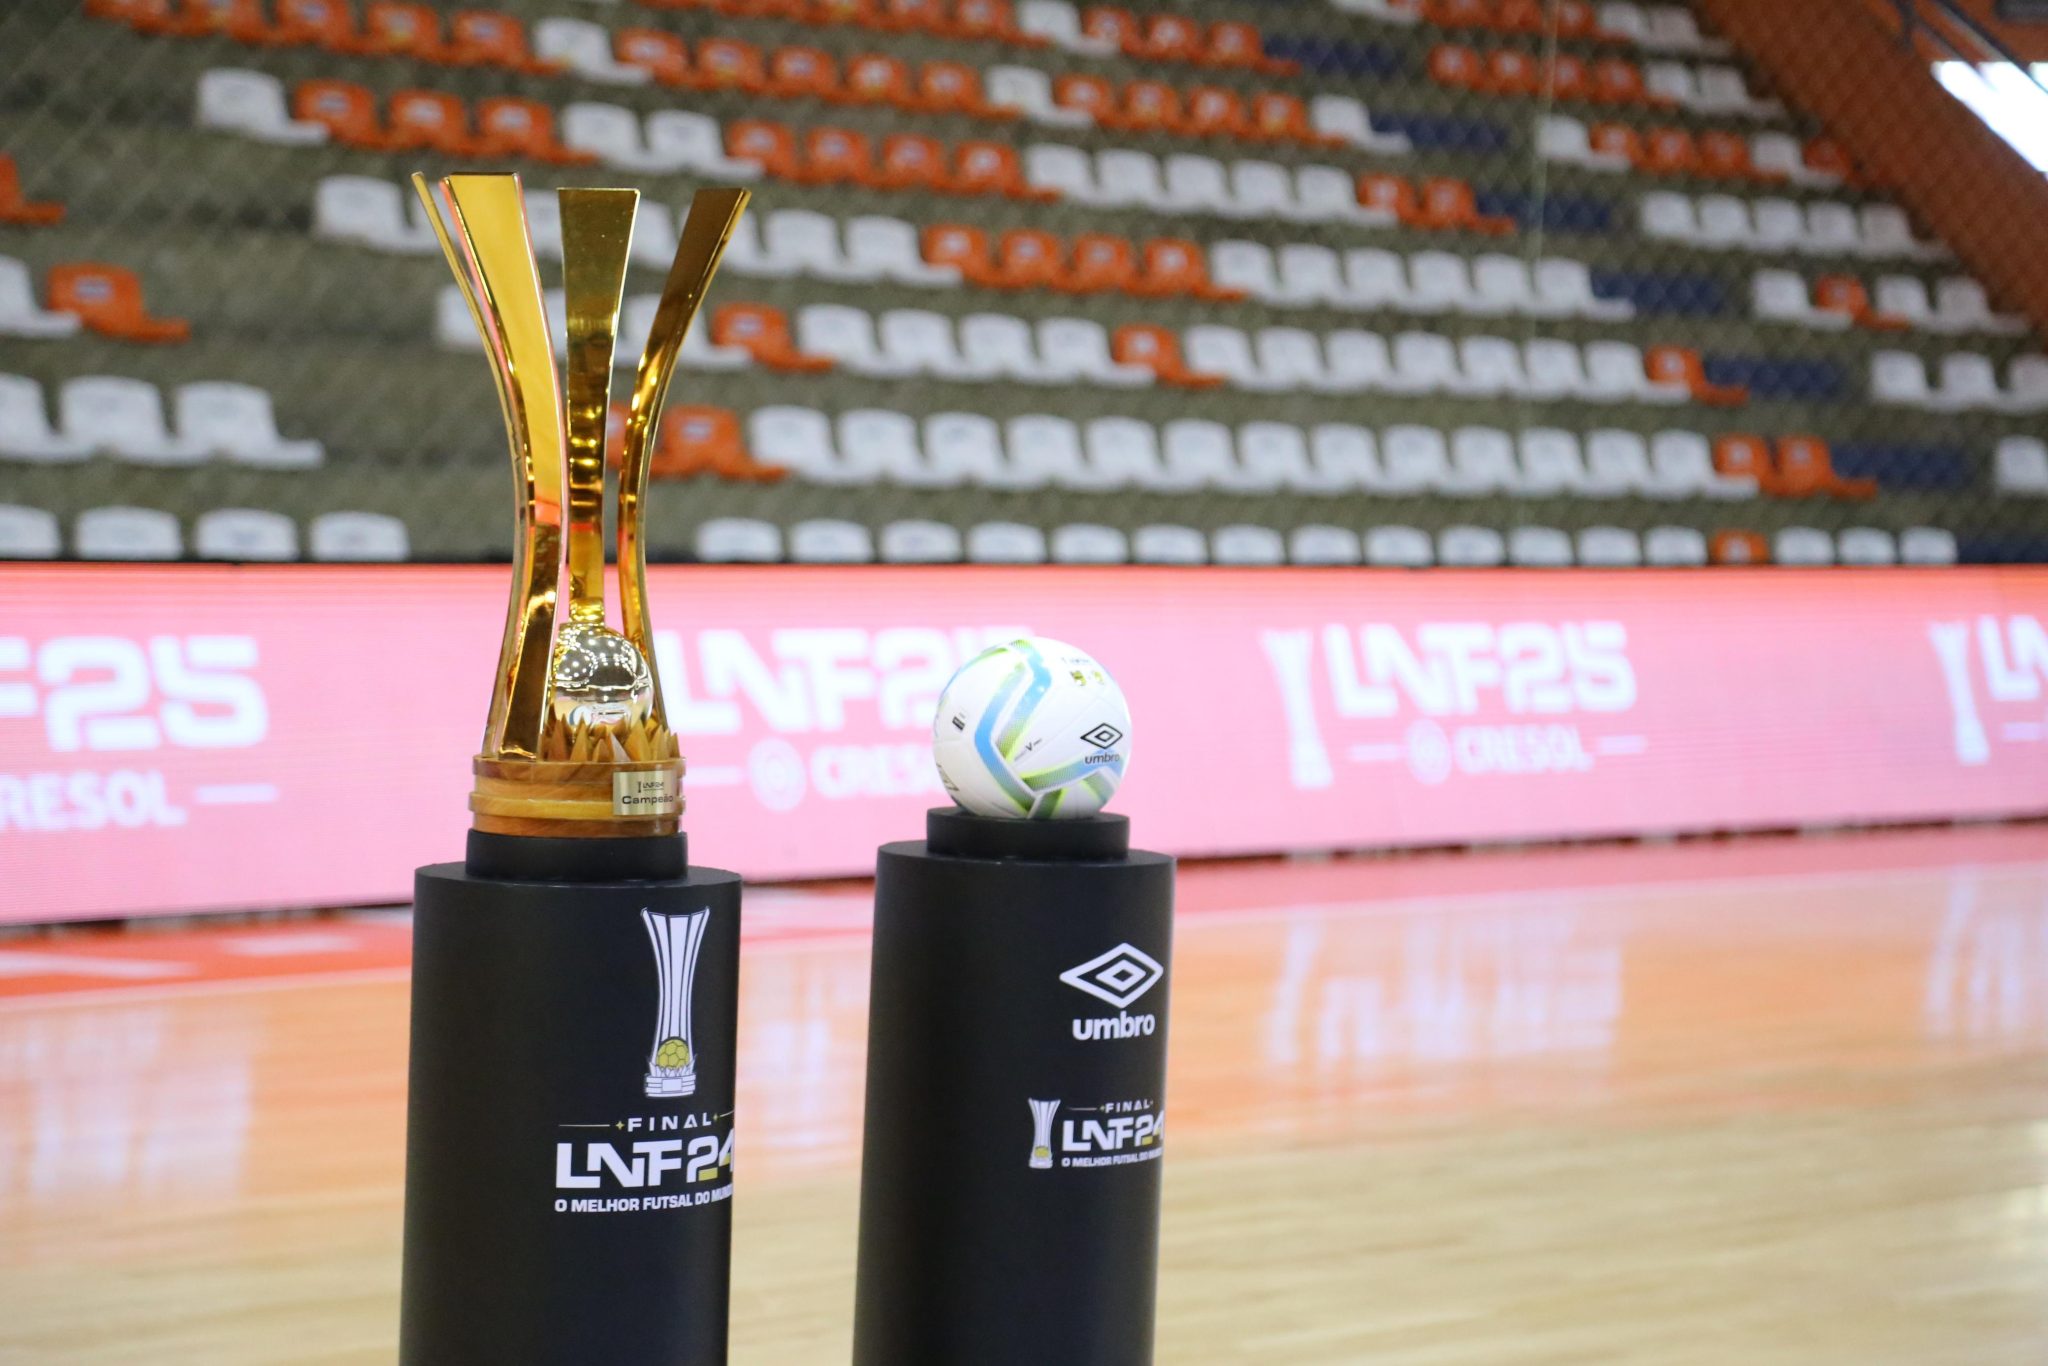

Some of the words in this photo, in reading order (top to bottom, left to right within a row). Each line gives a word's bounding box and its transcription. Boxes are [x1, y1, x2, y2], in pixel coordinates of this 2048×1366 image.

[1322, 620, 1638, 718] LNF25
[1084, 751, 1121, 765] umbro
[622, 793, 674, 806] Campeão
[1072, 1010, 1156, 1041] umbro
[1105, 1098, 1151, 1114] FINAL
[627, 1112, 712, 1133] FINAL
[1061, 1109, 1164, 1152] LNF24
[555, 1126, 735, 1189] LNF24
[1061, 1157, 1071, 1168] O
[1072, 1155, 1112, 1168] MELHOR
[554, 1198, 568, 1213] O
[571, 1197, 640, 1213] MELHOR
[642, 1193, 693, 1211] FUTSAL
[694, 1190, 710, 1206] DO
